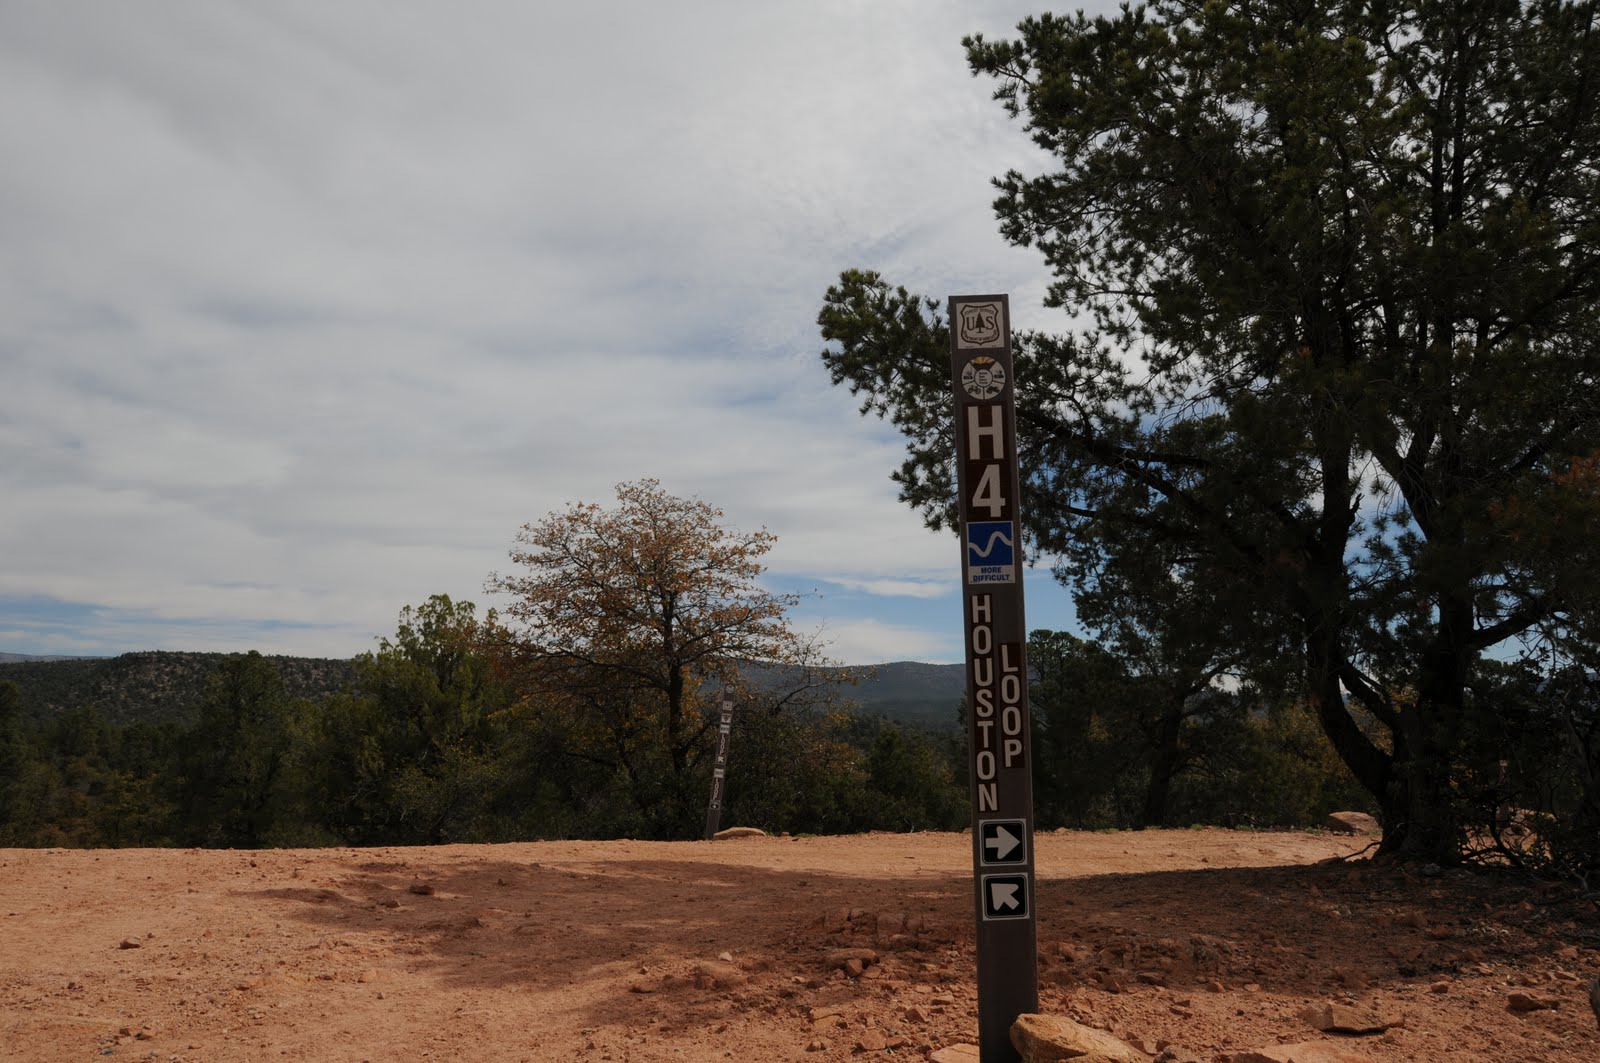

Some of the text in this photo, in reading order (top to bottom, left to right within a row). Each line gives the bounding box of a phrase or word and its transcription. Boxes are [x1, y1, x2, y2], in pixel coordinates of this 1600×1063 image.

[973, 574, 1010, 582] DIFFICULT
[980, 566, 1002, 574] MORE
[971, 594, 998, 812] HOUSTON
[1001, 644, 1023, 768] LOOP
